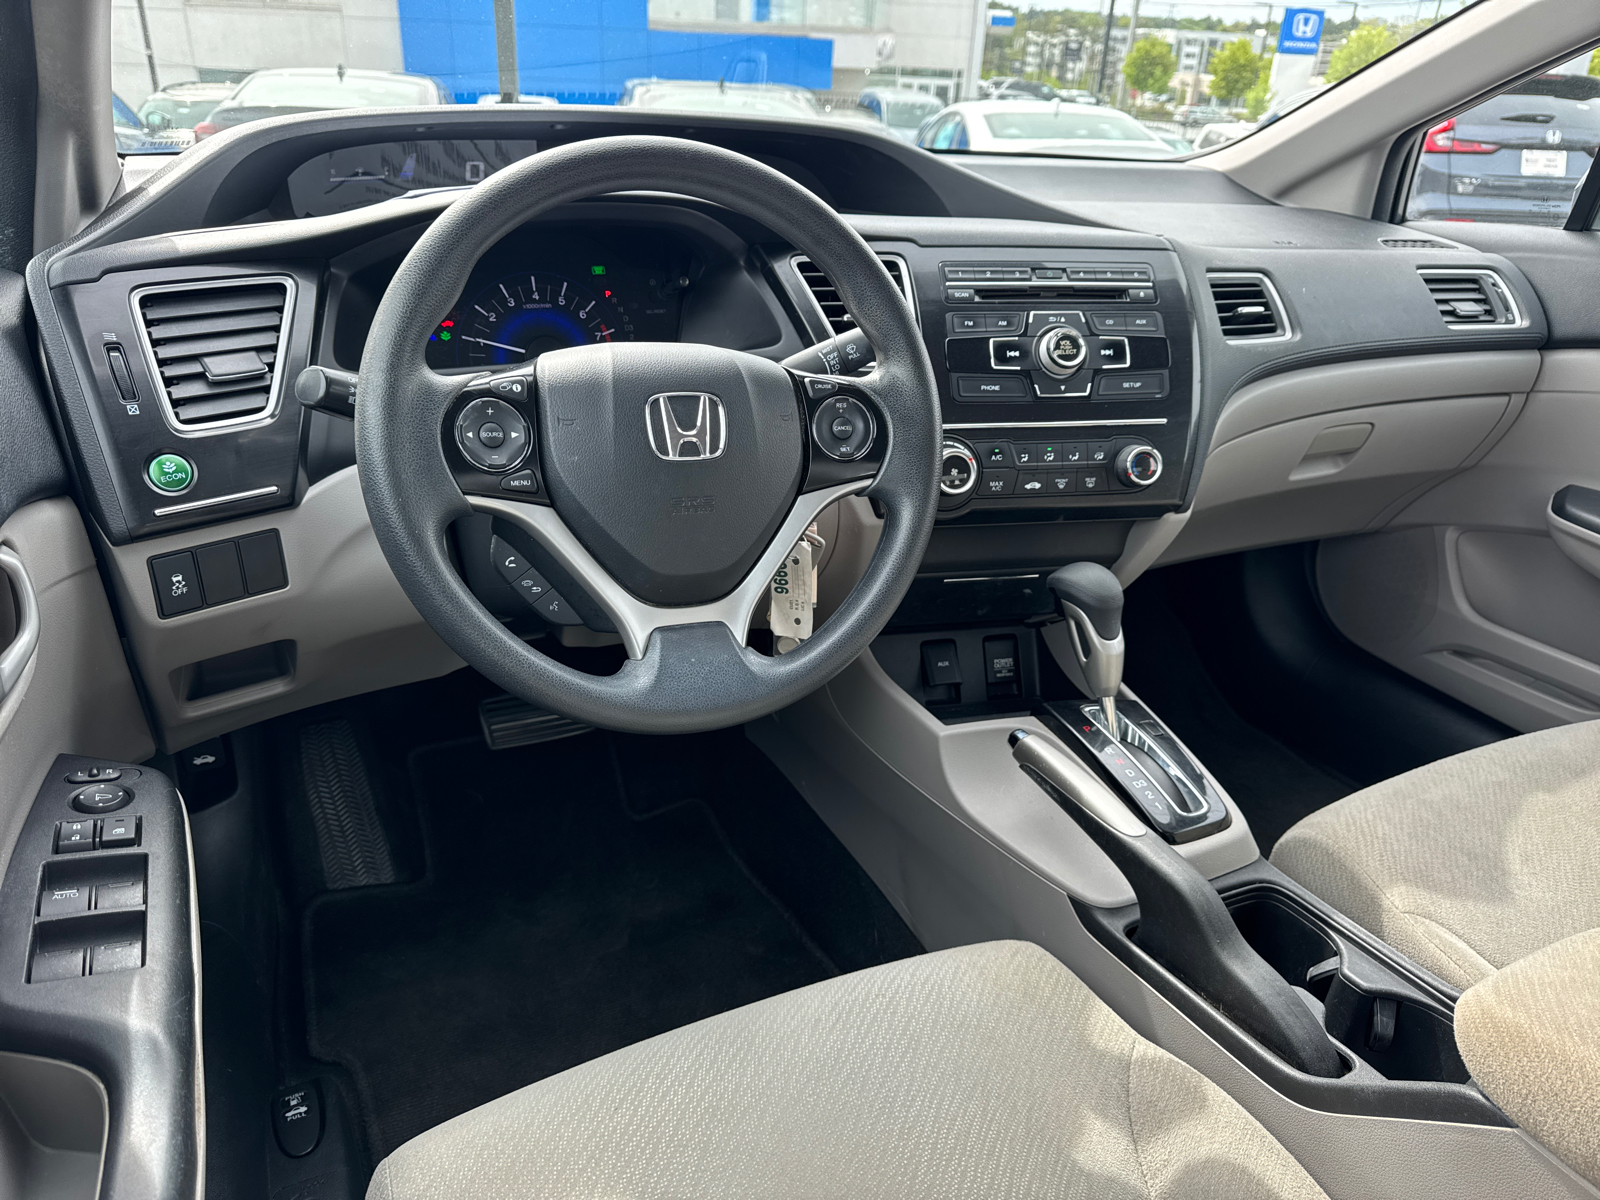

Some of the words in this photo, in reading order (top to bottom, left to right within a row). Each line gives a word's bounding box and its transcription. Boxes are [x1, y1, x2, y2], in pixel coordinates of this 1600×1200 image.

[532, 291, 540, 300] 4
[604, 290, 611, 298] P
[507, 297, 515, 306] 3
[558, 296, 566, 305] 5
[489, 312, 497, 321] 2
[579, 310, 587, 319] 6
[827, 352, 838, 360] OFF
[848, 352, 860, 360] PULL
[160, 472, 186, 483] ECON
[671, 495, 716, 506] SRS
[672, 507, 716, 515] AIRBAG
[172, 587, 188, 596] OFF
[1125, 769, 1135, 777] D
[1145, 790, 1155, 799] 2
[52, 892, 79, 900] AUTO
[285, 1092, 305, 1101] PUSH
[287, 1112, 307, 1121] PULL
